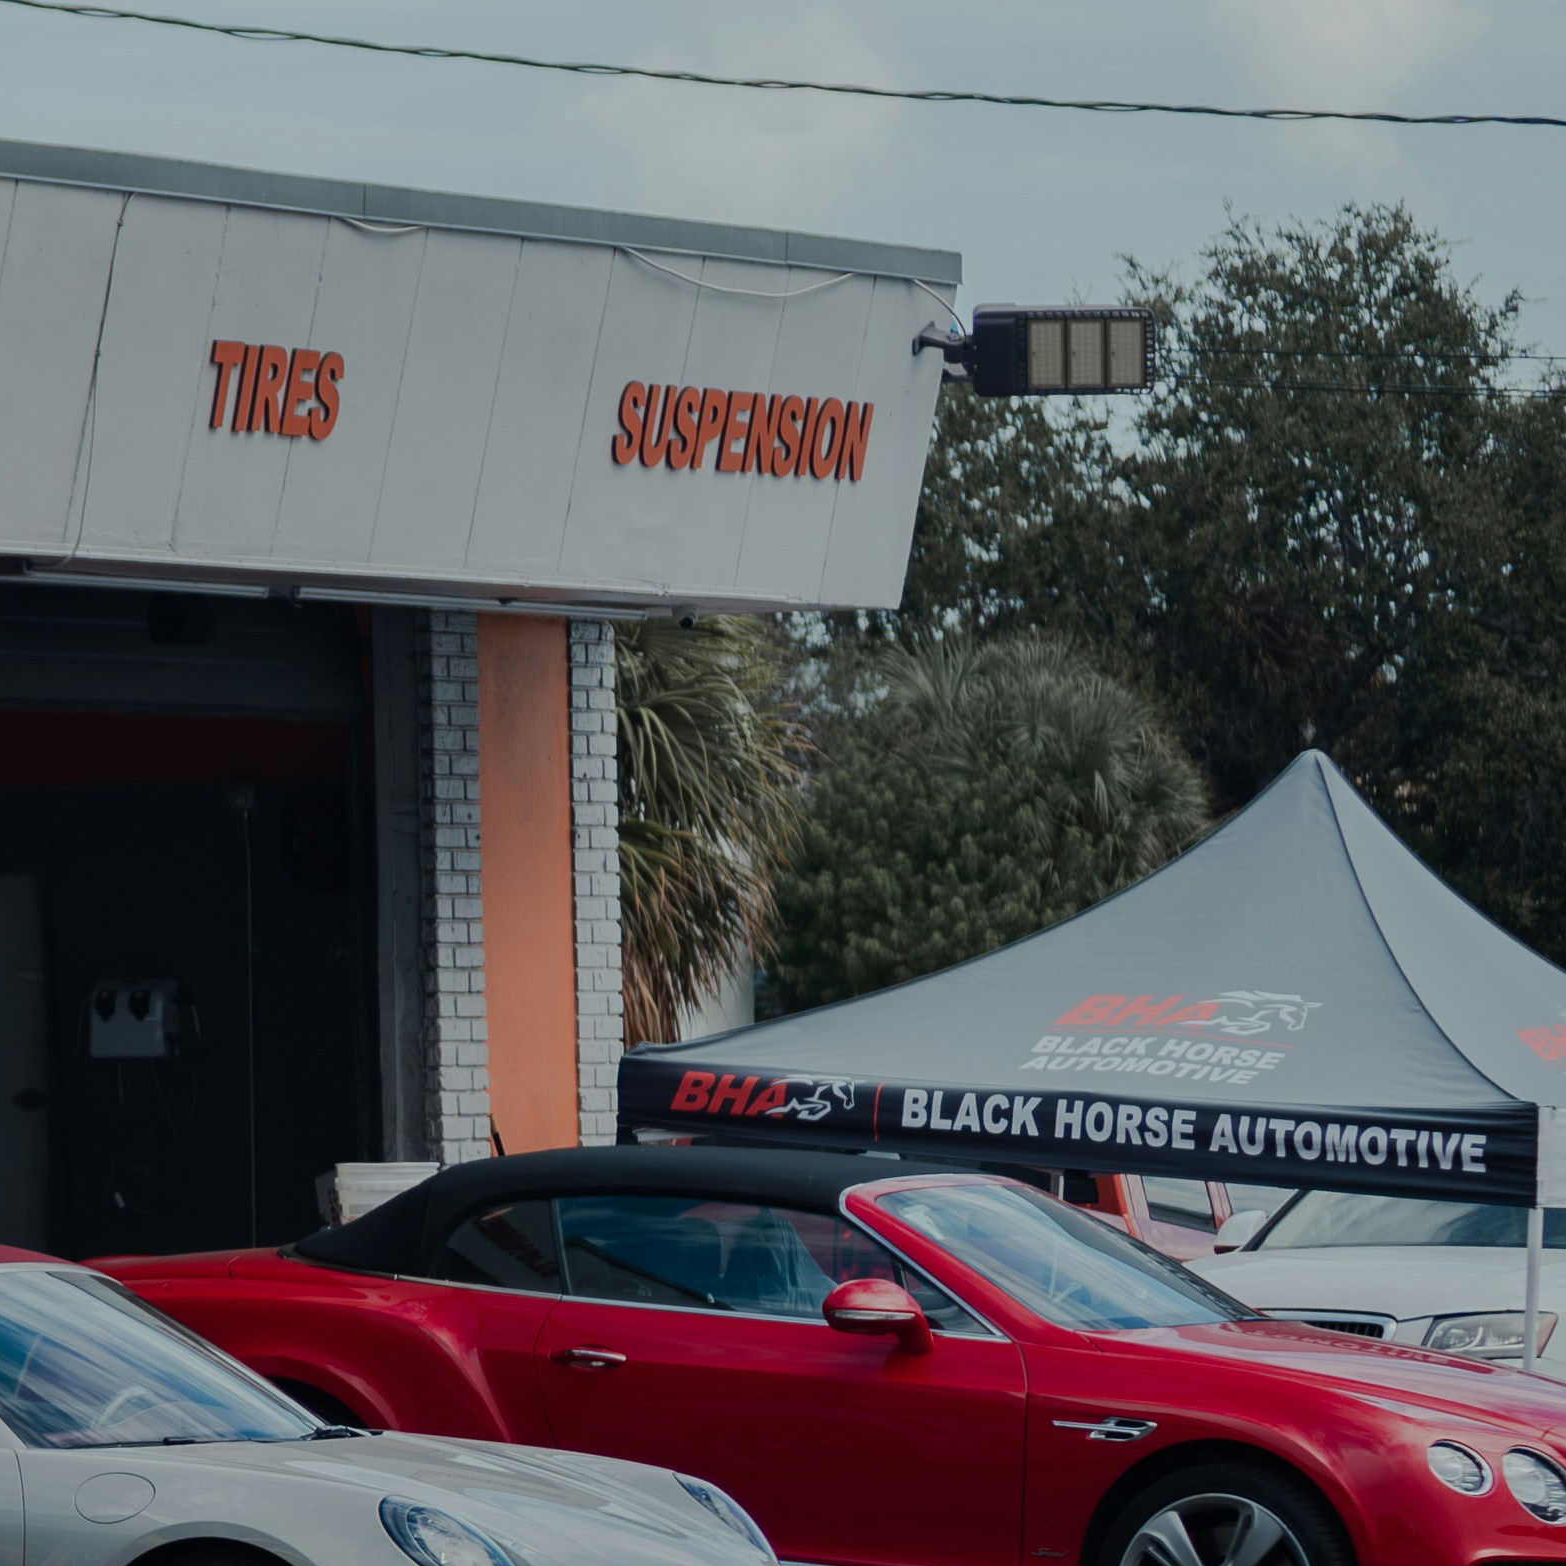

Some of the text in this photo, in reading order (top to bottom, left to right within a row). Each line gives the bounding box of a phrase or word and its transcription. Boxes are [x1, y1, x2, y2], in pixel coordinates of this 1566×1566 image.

[210, 340, 344, 440] TIRES
[612, 381, 874, 482] SUSPENSION
[1055, 994, 1220, 1030] BHA
[1019, 1055, 1260, 1085] AUTOMOTIVE
[1030, 1034, 1286, 1070] BLACK HORSE
[670, 1070, 1487, 1173] BHA BLACK HORSE AUTOMOTIVE
